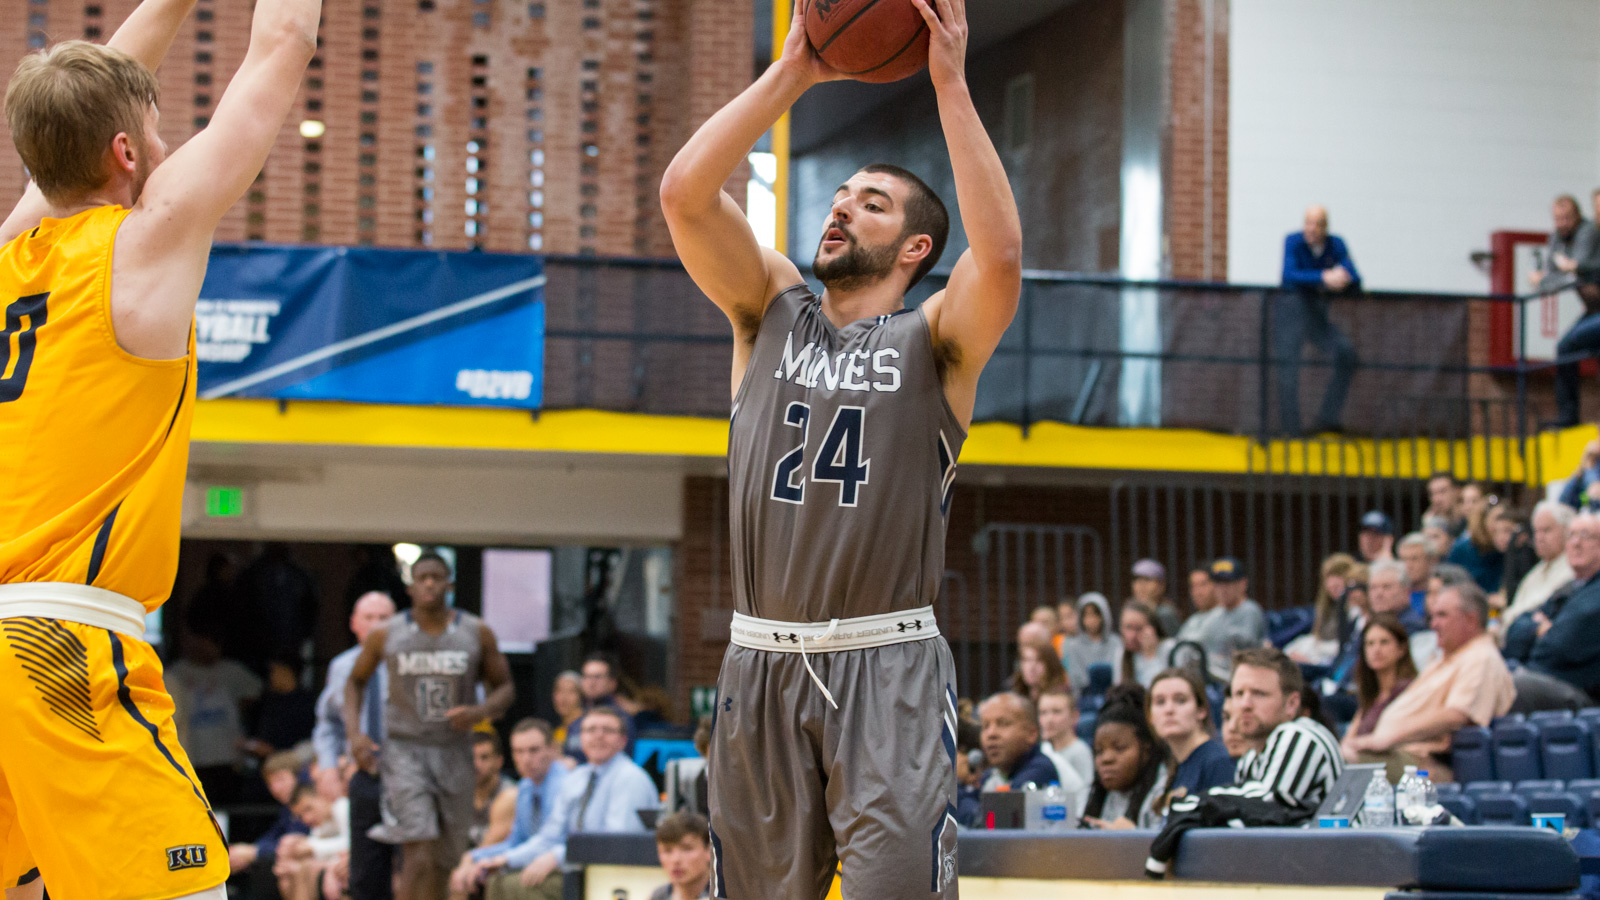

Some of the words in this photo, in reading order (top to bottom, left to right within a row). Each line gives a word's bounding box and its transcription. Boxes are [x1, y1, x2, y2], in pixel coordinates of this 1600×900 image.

[774, 331, 902, 392] MINES
[770, 401, 872, 508] 24
[397, 650, 469, 675] MINES
[165, 844, 208, 871] RU
